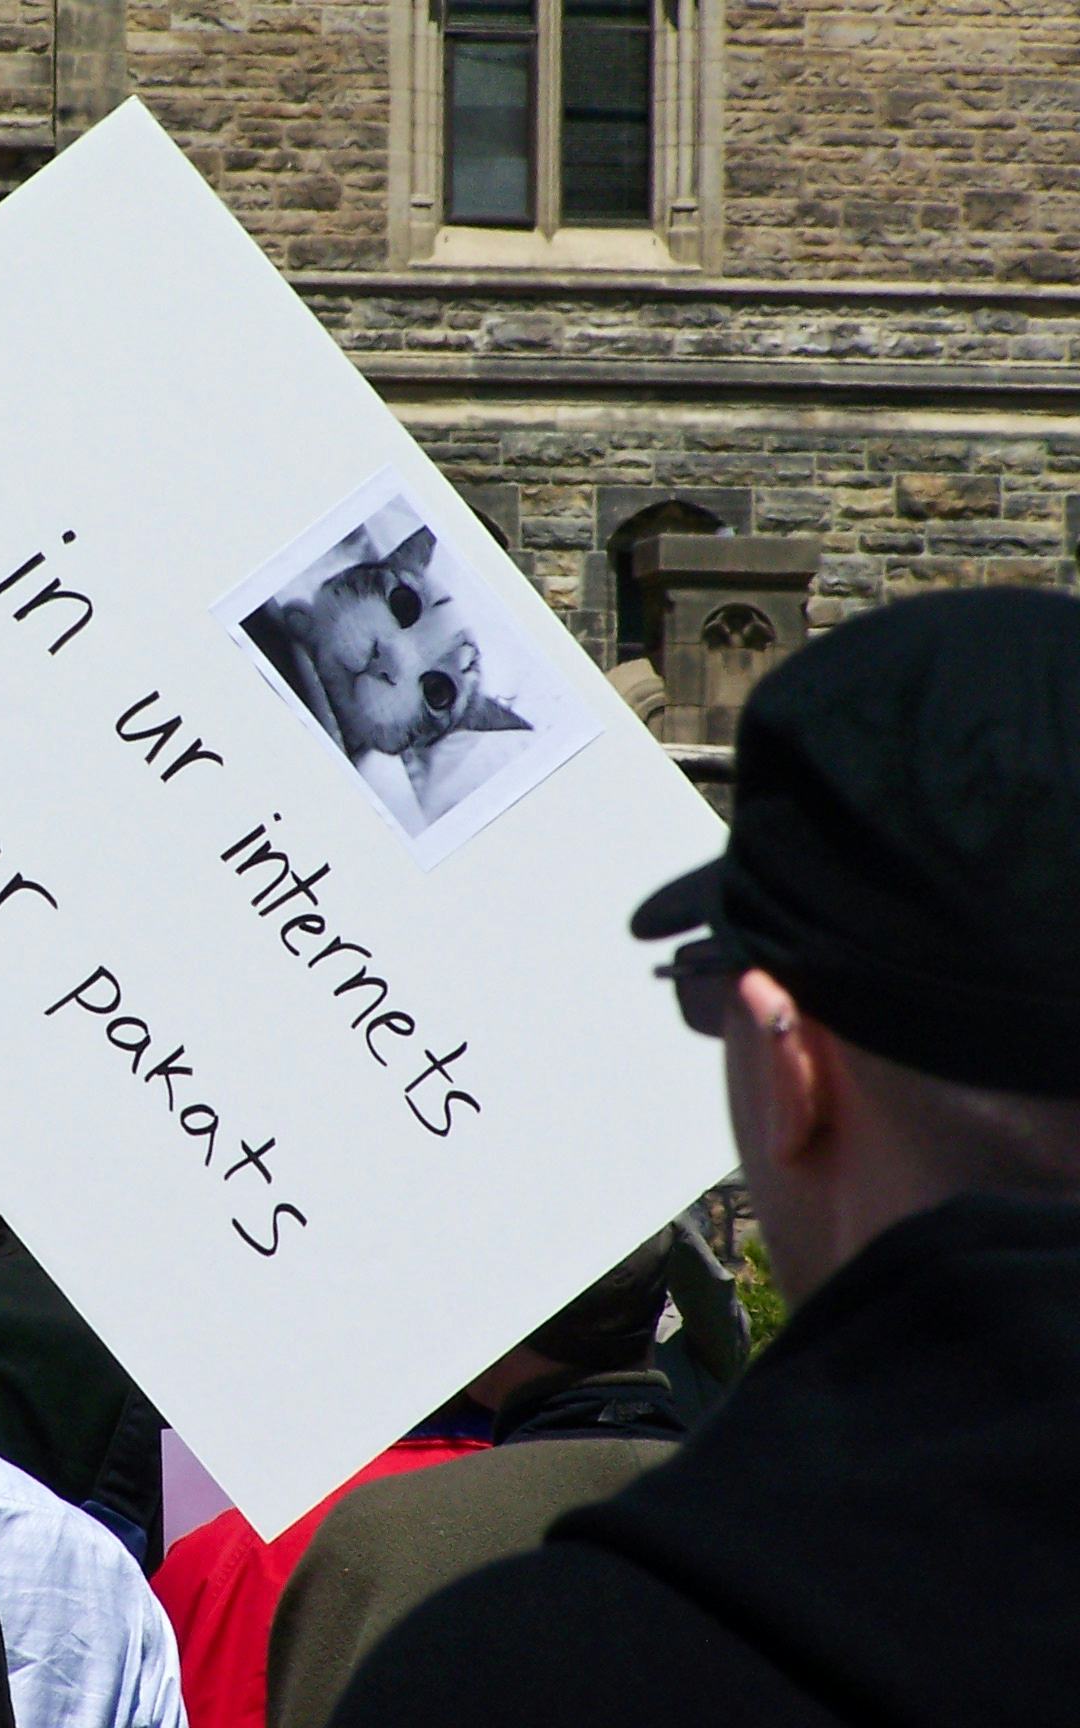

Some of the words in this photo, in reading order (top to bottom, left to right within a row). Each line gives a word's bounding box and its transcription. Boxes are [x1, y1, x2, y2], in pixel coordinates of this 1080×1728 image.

[115, 690, 224, 783] ur
[220, 813, 481, 1137] internets
[44, 966, 309, 1257] pakats
